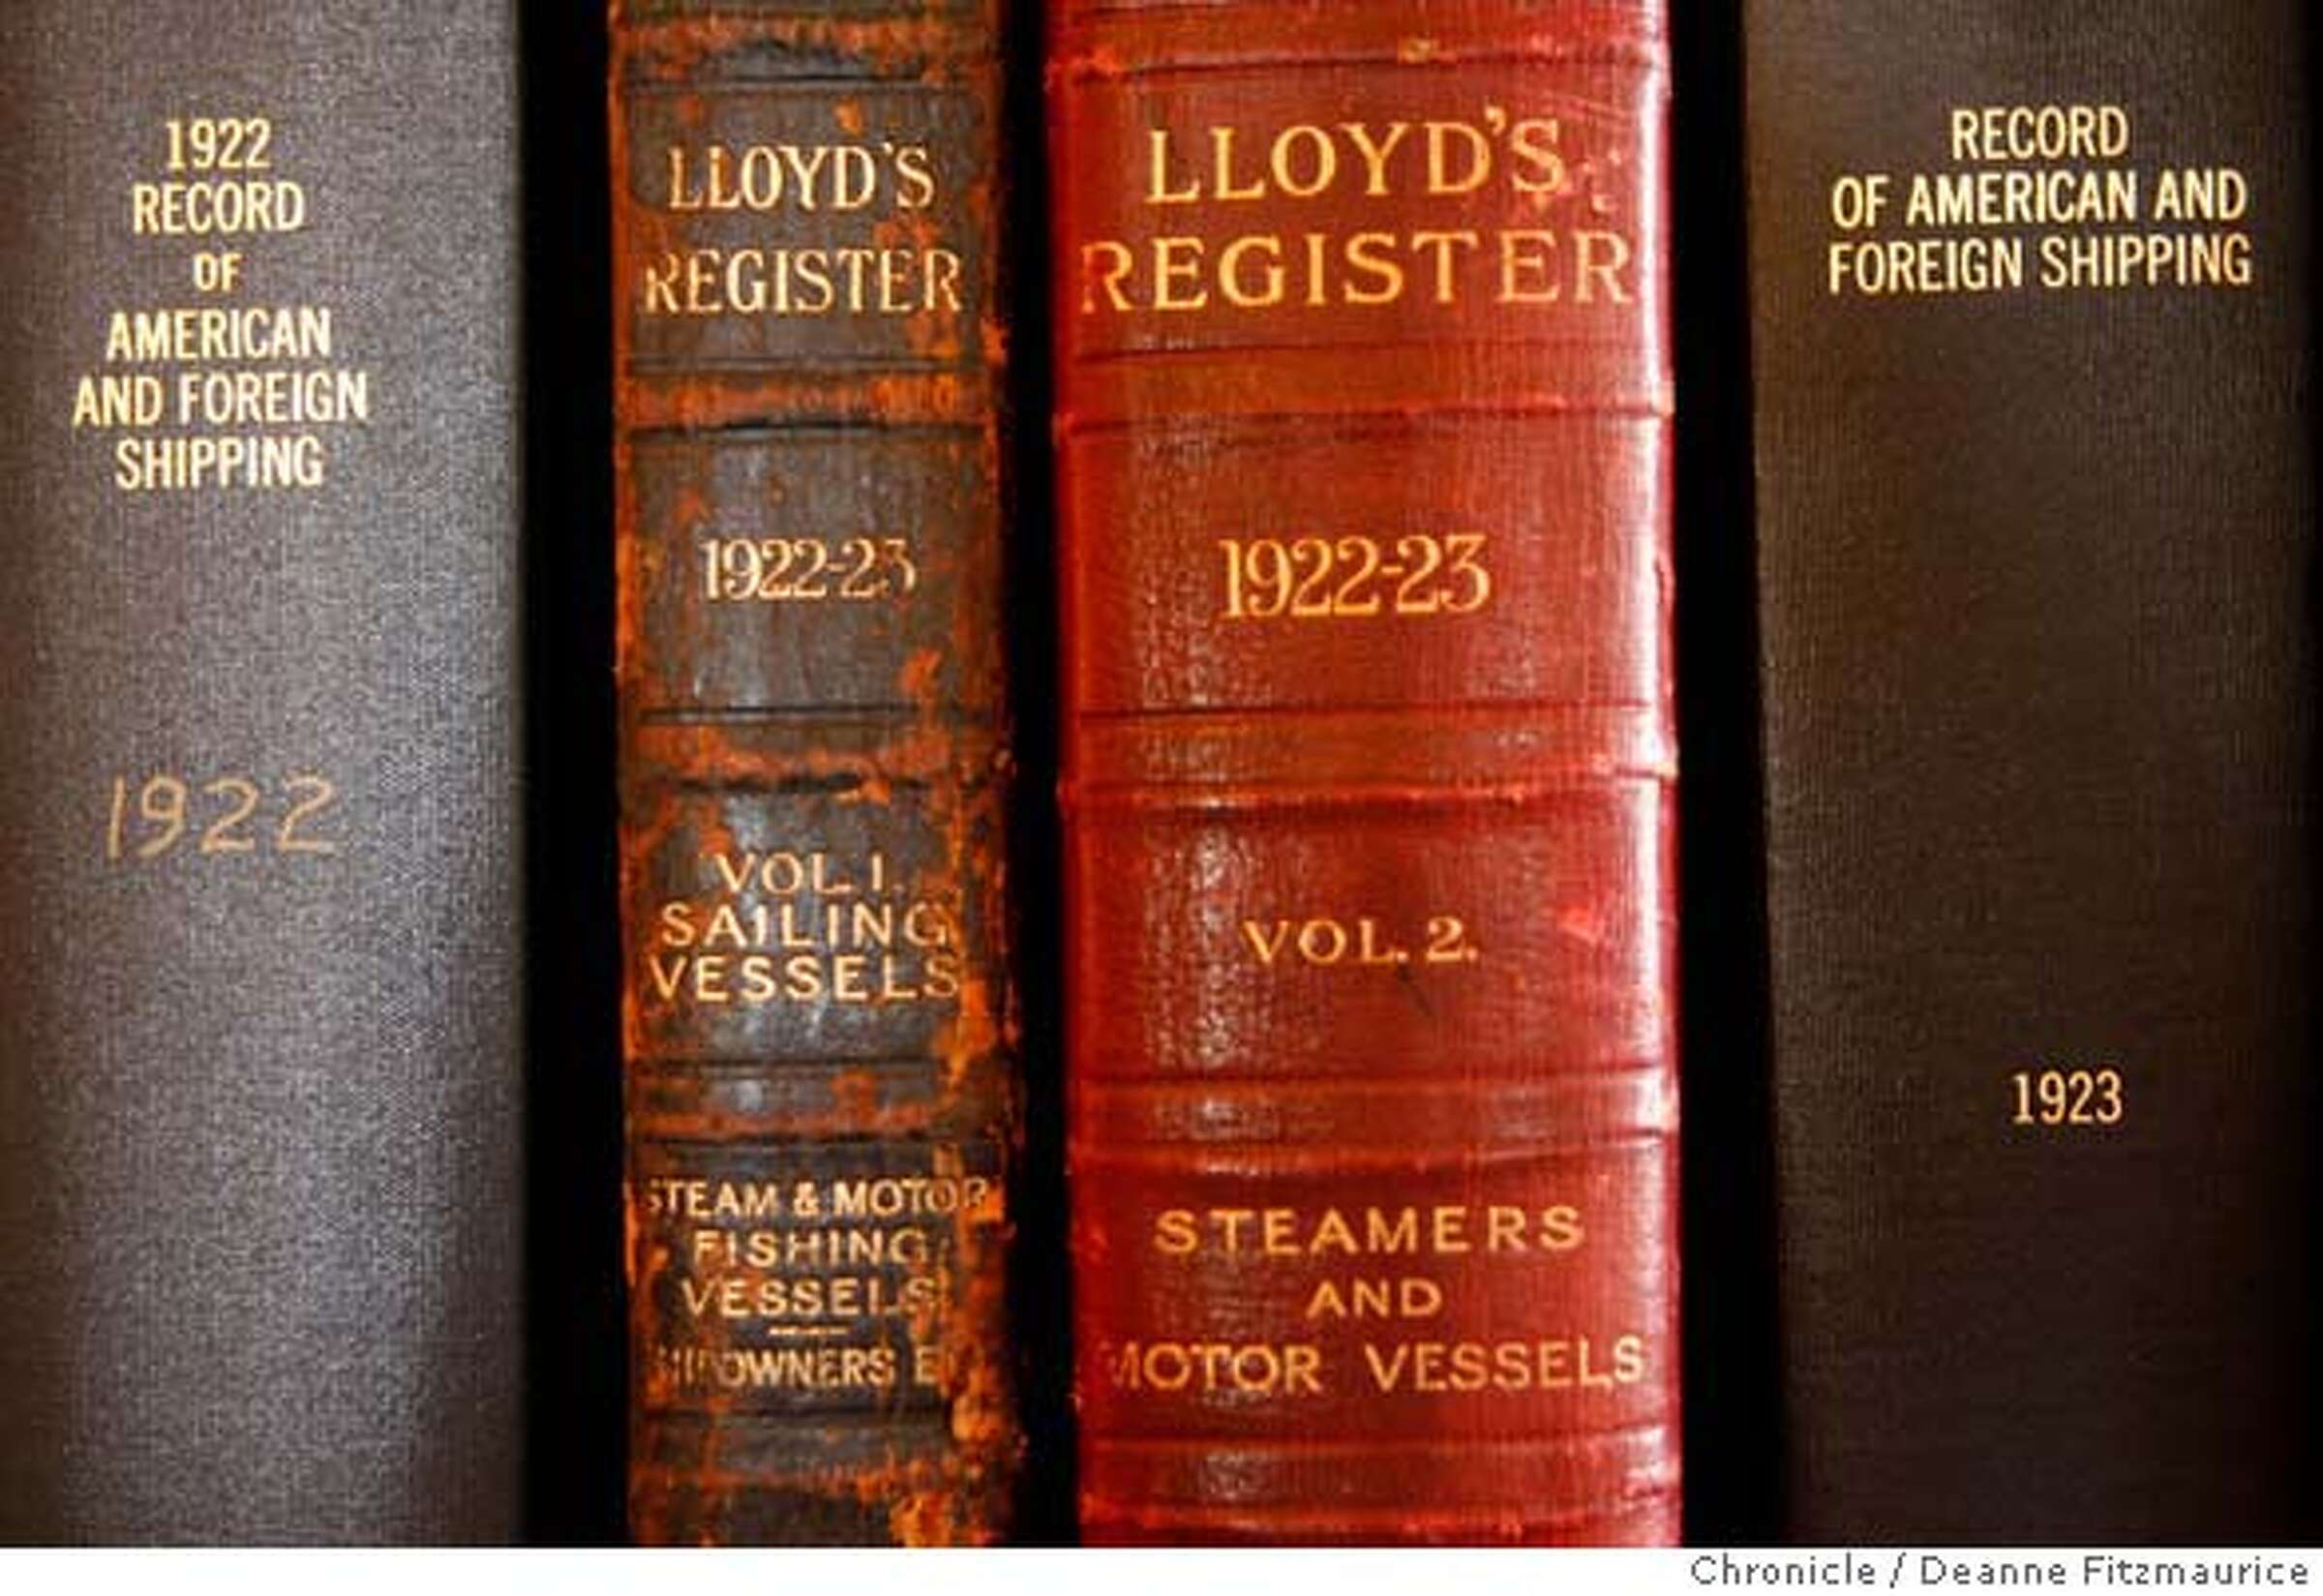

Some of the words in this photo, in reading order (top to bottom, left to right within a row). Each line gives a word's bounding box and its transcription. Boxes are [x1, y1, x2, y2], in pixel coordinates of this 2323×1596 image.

[166, 118, 272, 170] 1922
[1145, 106, 1565, 204] LLOYD'S
[1951, 105, 2129, 161] RECORD
[669, 141, 936, 211] LLOYD'S
[1831, 174, 1889, 229] OF
[1906, 170, 2137, 227] AMERICAN
[2154, 167, 2249, 222] AND
[133, 182, 305, 234] RECORD
[194, 253, 242, 291] OF
[645, 248, 962, 314] REGISTER
[1081, 229, 1635, 315] REGISTER
[1828, 238, 2023, 296] FOREIGN
[2039, 233, 2252, 287] SHIPPING
[106, 308, 332, 361] AMERICAN
[73, 376, 163, 427] AND
[179, 370, 369, 426] FOREIGN
[115, 436, 325, 491] SHIPPING
[1220, 532, 1492, 620] 1922-23
[108, 773, 335, 859] 1922
[661, 902, 947, 949] SAILING
[1241, 918, 1409, 965] VOL.
[1425, 916, 1479, 963] 2.
[650, 952, 960, 1003] VESSELS
[2011, 1069, 2124, 1125] 1923
[794, 1181, 821, 1218] &
[693, 1226, 929, 1267] FISHING
[1155, 1205, 1587, 1256] STEAMERS
[682, 1276, 944, 1317] VESSELS
[1306, 1280, 1443, 1320] AND
[1365, 1334, 1648, 1393] VESSELS
